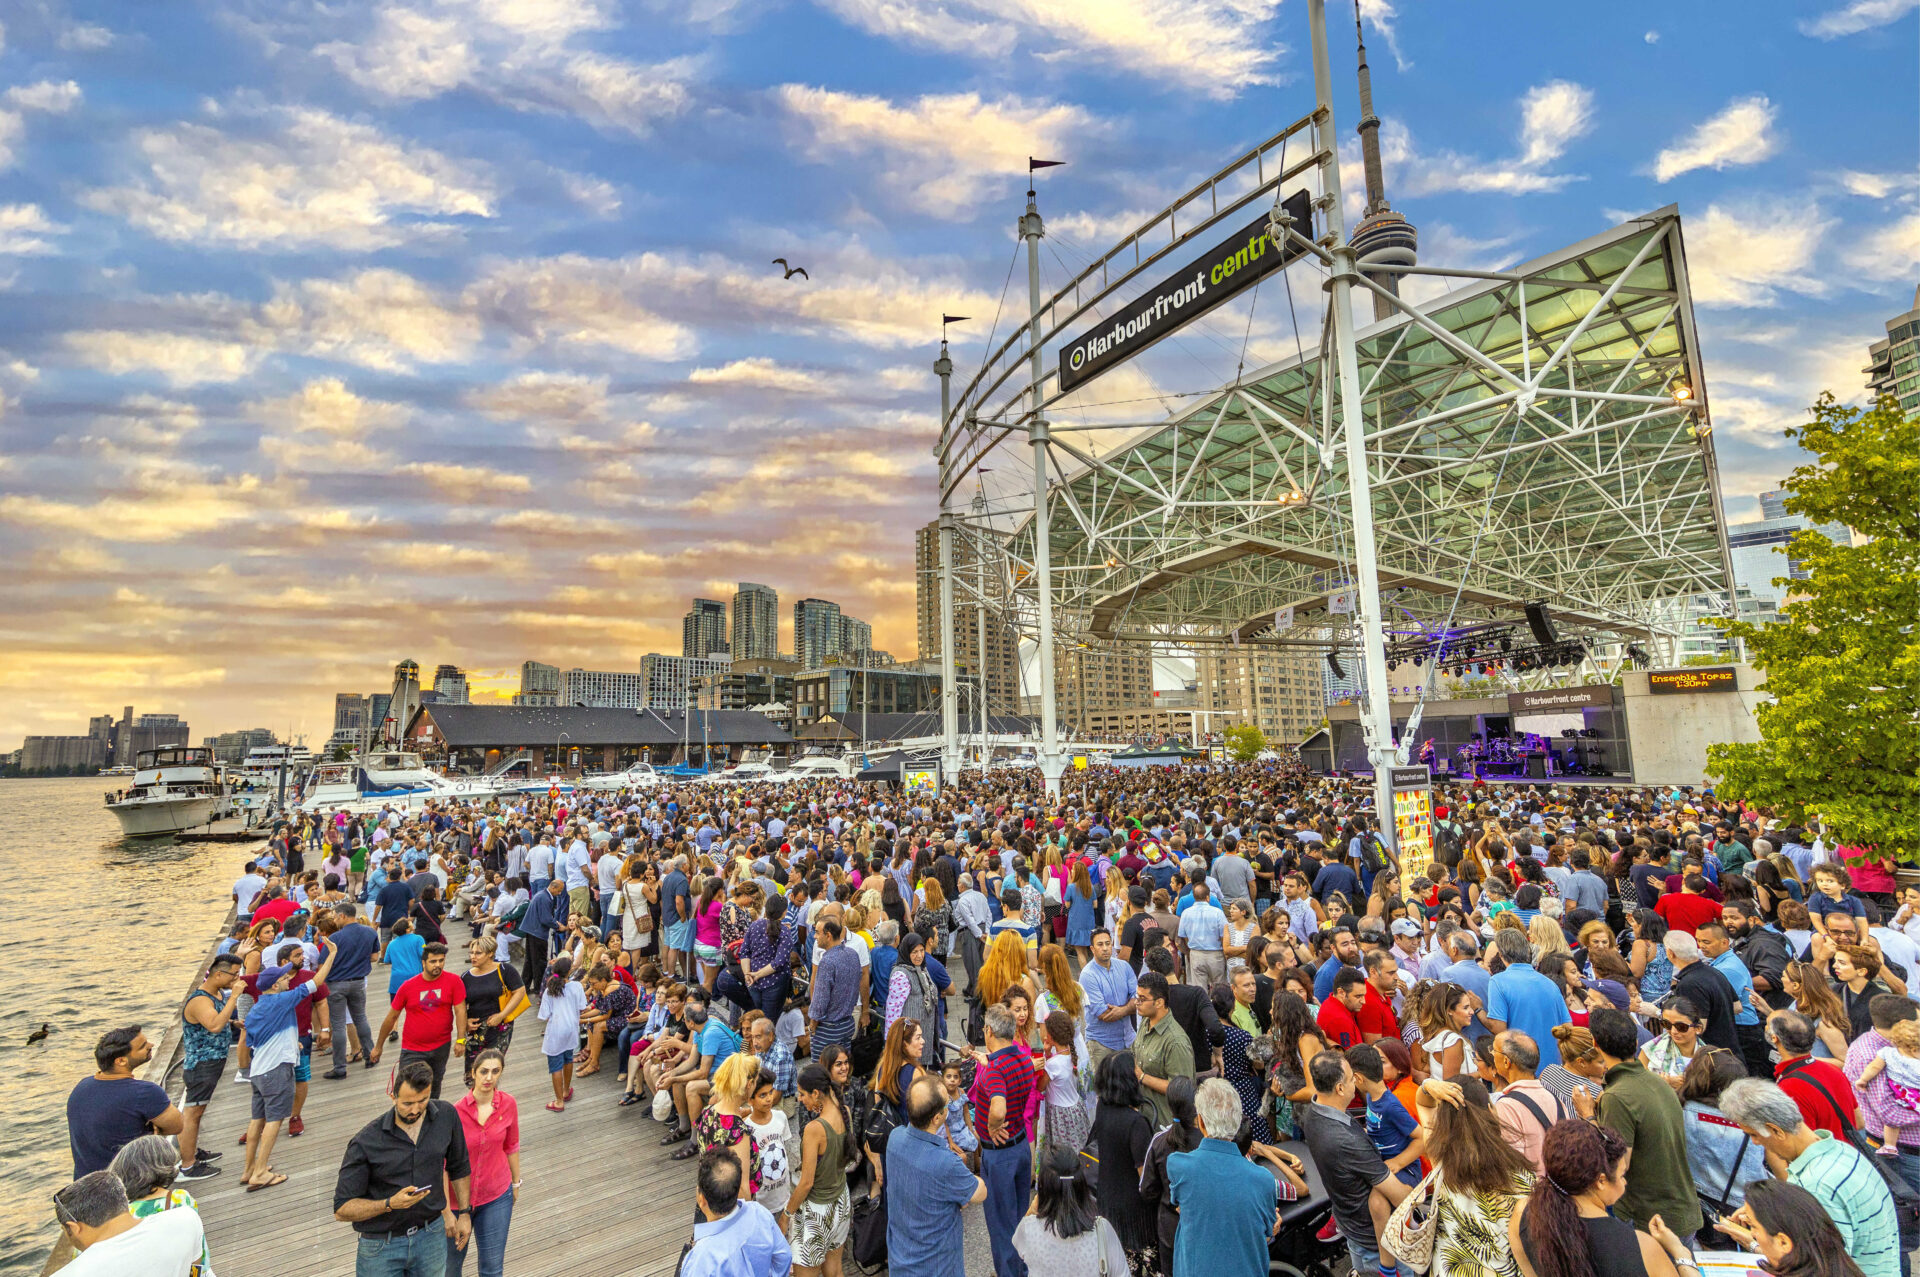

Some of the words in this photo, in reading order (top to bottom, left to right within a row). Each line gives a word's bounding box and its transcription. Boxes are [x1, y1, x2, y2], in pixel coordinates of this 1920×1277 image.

[1087, 271, 1206, 362] Harbourfront
[1651, 674, 1697, 683] Ensemble
[1700, 672, 1733, 681] Topaz
[1676, 680, 1709, 688] 1:30pm
[1530, 694, 1569, 705] Harbourfront
[1570, 693, 1591, 702] centre
